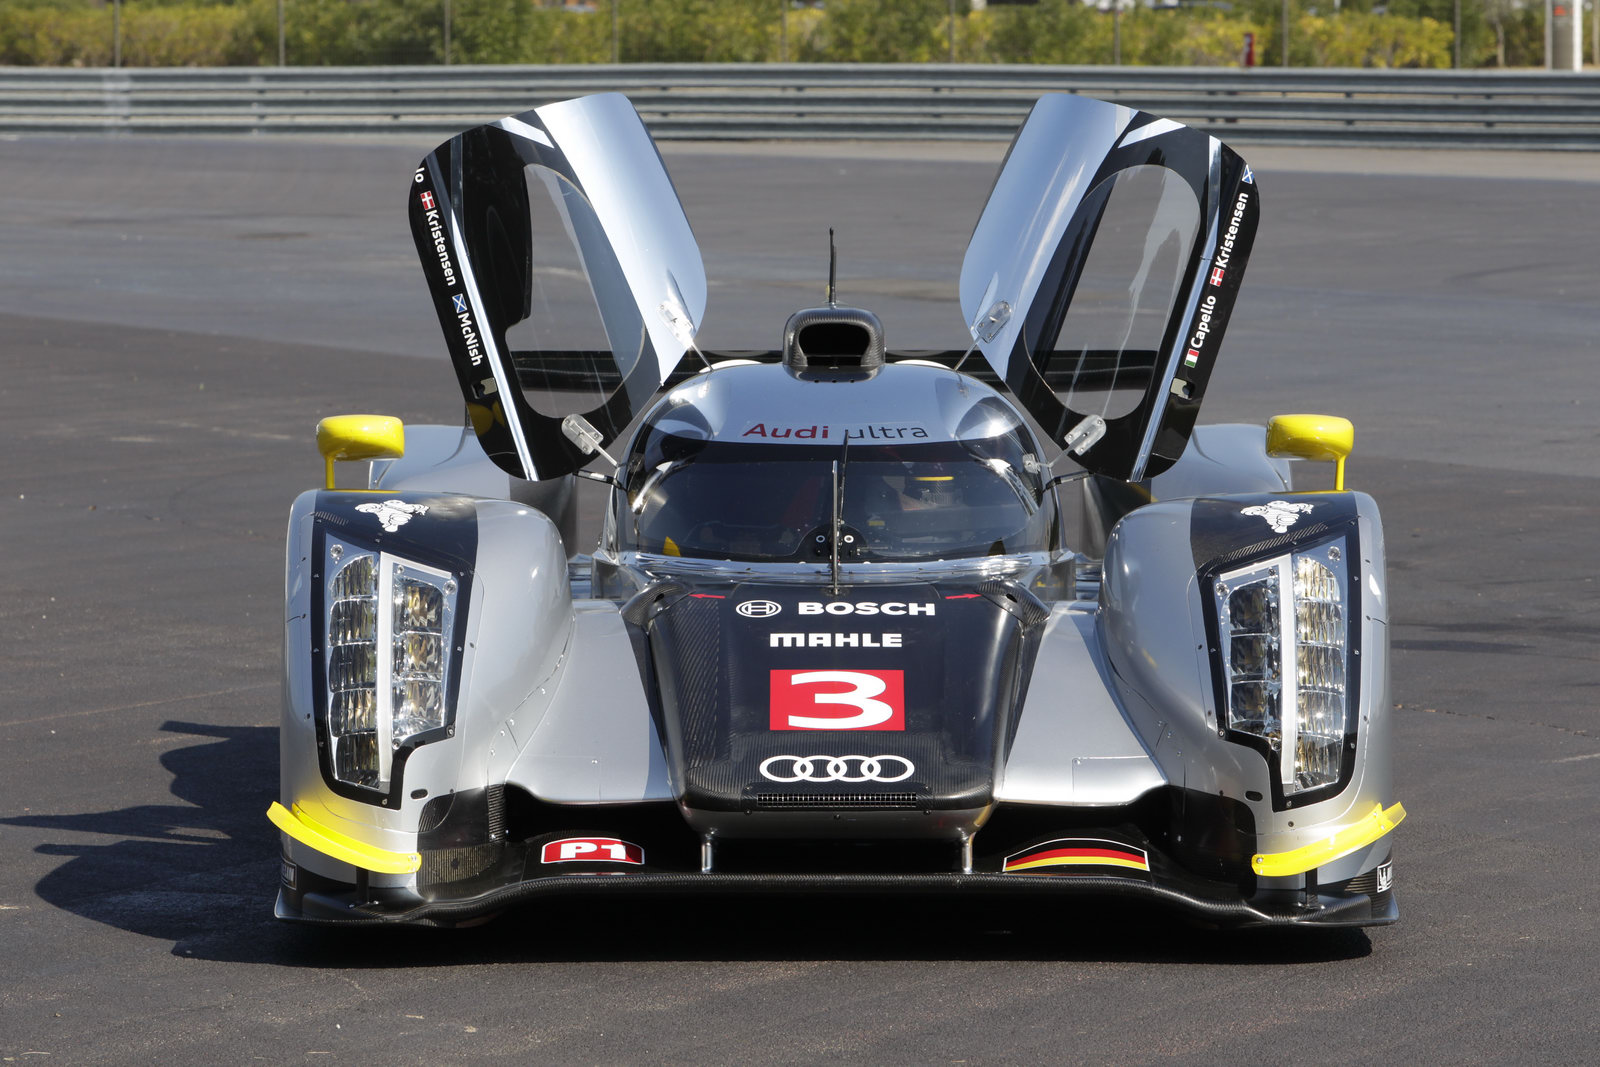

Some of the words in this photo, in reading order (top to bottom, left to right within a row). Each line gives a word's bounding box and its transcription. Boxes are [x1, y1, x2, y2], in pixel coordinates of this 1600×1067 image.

[1190, 295, 1217, 349] Capello
[1215, 193, 1249, 268] Kristensen
[426, 209, 456, 286] Kristensen
[457, 313, 484, 366] McNish
[742, 423, 829, 439] Audi
[845, 425, 929, 439] ultra
[798, 602, 936, 616] BOSCH
[769, 633, 903, 647] MAHLE
[788, 671, 893, 729] 3
[560, 842, 626, 860] P1
